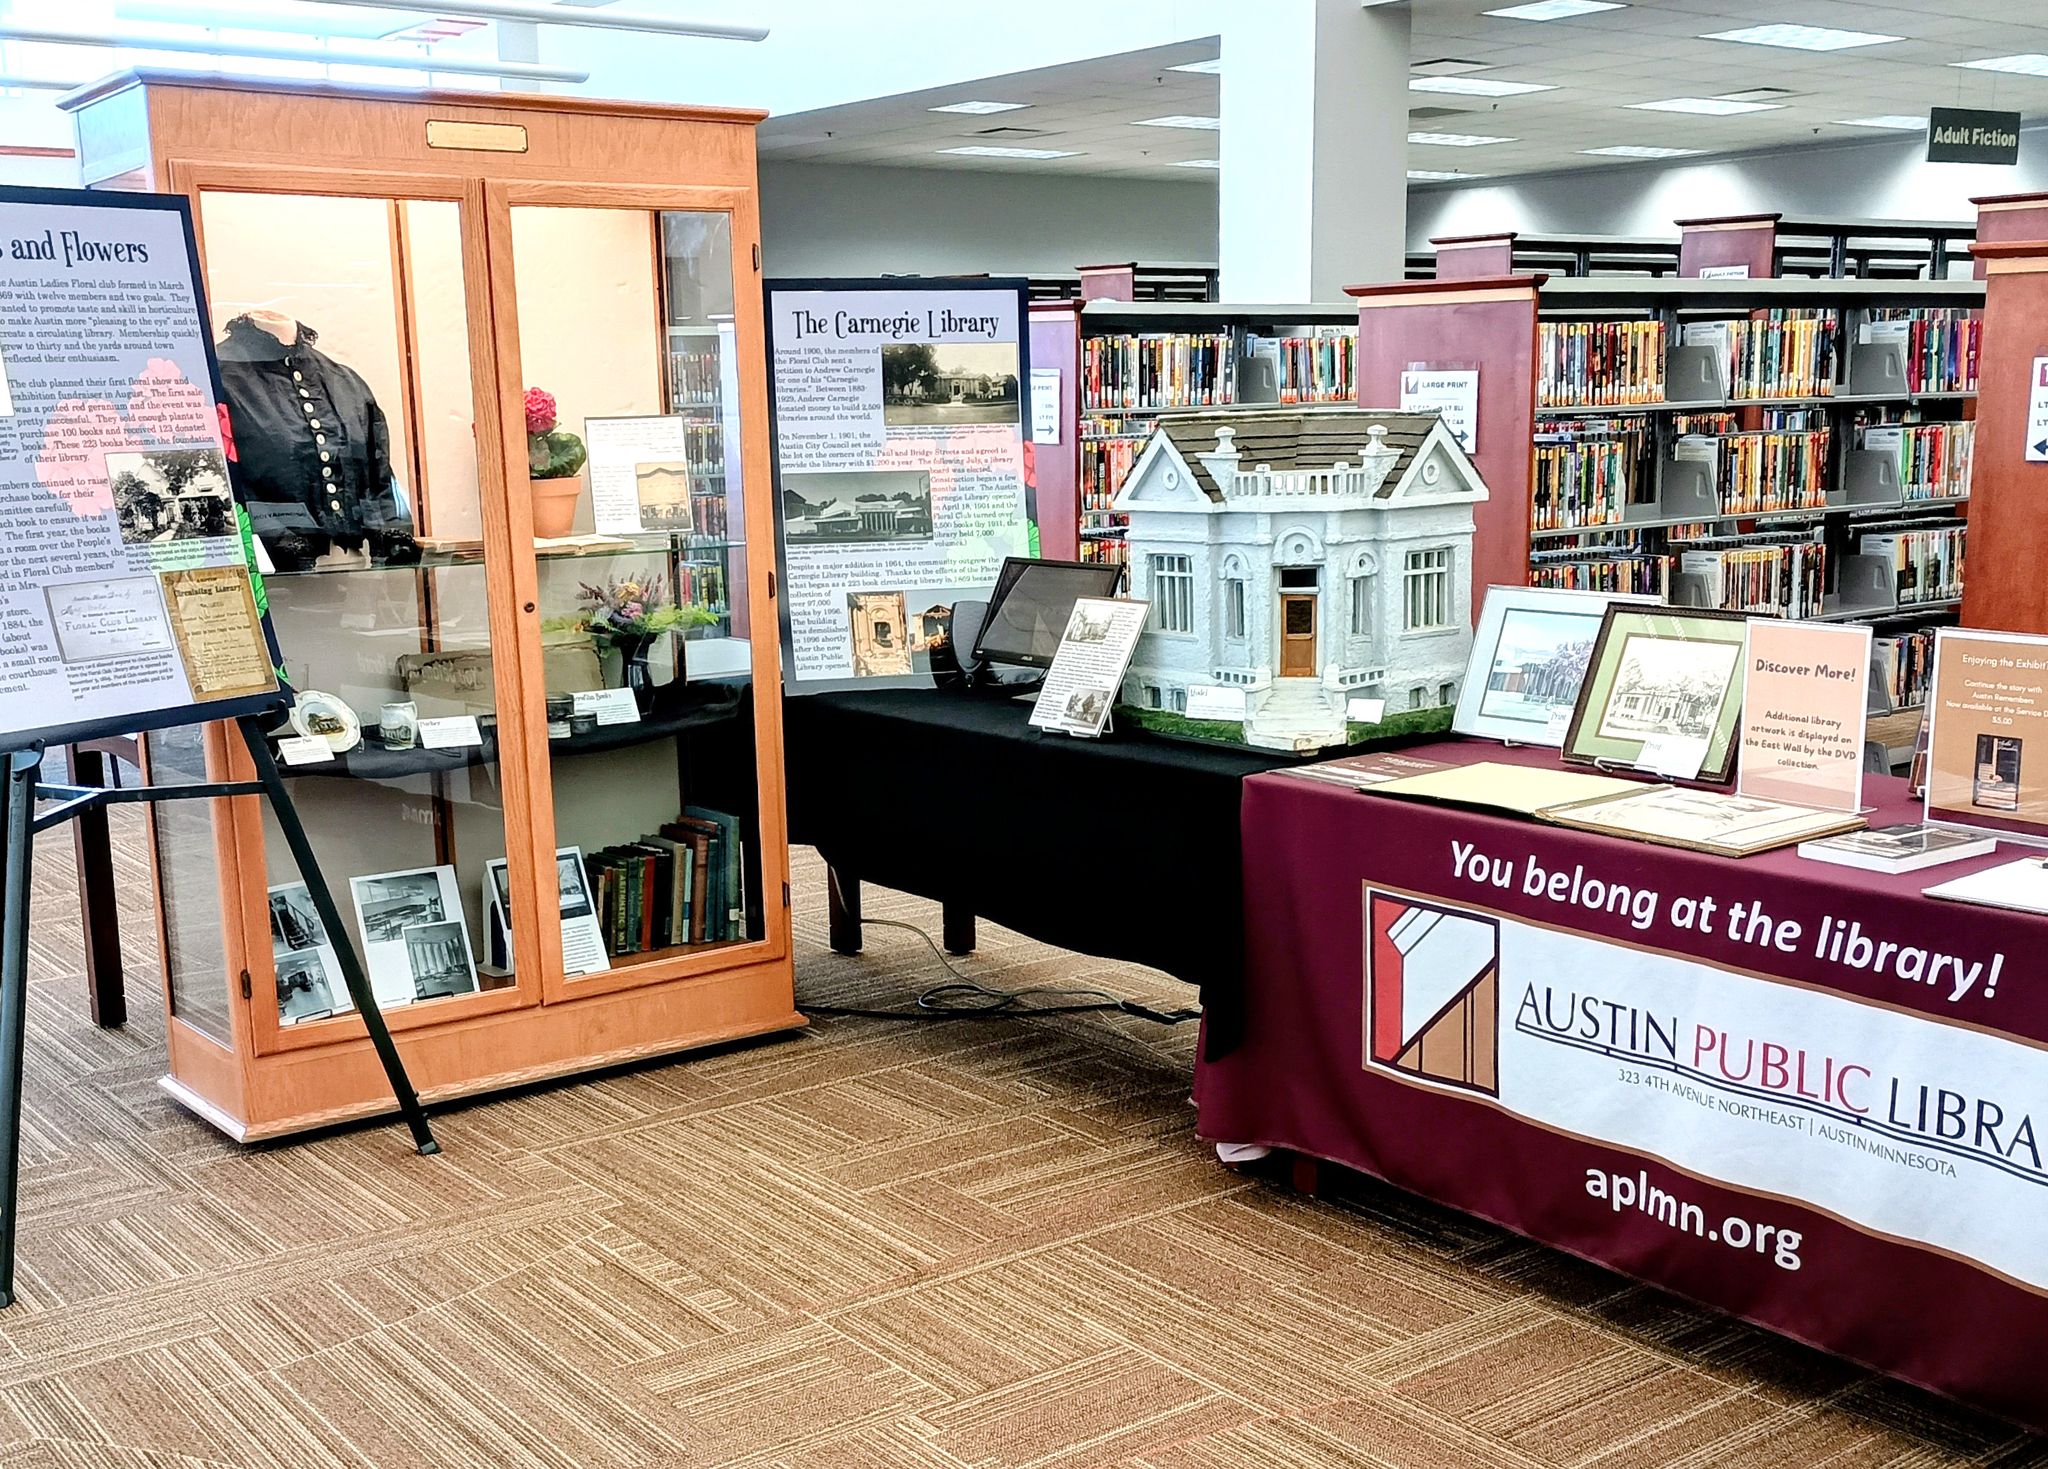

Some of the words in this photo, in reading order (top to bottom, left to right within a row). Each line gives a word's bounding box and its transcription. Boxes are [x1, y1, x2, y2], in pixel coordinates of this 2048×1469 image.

[1934, 126, 1969, 144] Adult
[1972, 128, 2016, 147] Fiction
[11, 230, 56, 260] and
[61, 232, 148, 267] Flowers
[8, 278, 38, 287] Austin
[40, 279, 69, 288] Ladies
[71, 279, 97, 288] Floral
[98, 280, 116, 288] club
[118, 280, 147, 289] formed
[148, 280, 157, 289] in
[158, 280, 185, 290] March
[14, 291, 36, 300] with
[37, 291, 66, 300] twelve
[68, 292, 107, 301] members
[109, 292, 124, 301] and
[126, 292, 142, 301] two
[143, 293, 166, 304] goals.
[170, 293, 190, 304] They
[29, 304, 38, 313] to
[40, 305, 76, 315] promote
[77, 305, 99, 313] taste
[100, 305, 117, 313] and
[118, 305, 136, 314] skill
[138, 305, 147, 314] in
[148, 306, 196, 314] horticulture
[7, 317, 32, 325] make
[34, 317, 63, 325] Austin
[129, 317, 137, 325] to
[139, 317, 153, 325] the
[173, 317, 188, 325] and
[189, 317, 198, 325] to
[792, 310, 828, 339] The
[835, 310, 921, 339] Carnegie
[927, 309, 1000, 339] Library
[36, 329, 83, 340] circulating
[84, 329, 115, 340] library.
[119, 329, 170, 339] Membership
[171, 328, 199, 339] quickly
[824, 347, 836, 355] the
[775, 367, 803, 375] petition
[843, 366, 876, 375] Carnegie
[5, 531, 24, 540] The
[26, 529, 45, 539] first
[46, 530, 69, 539] year,
[70, 526, 85, 536] the
[86, 525, 111, 534] books
[60, 540, 75, 549] the
[11, 556, 26, 565] the
[28, 554, 48, 564] next
[50, 552, 82, 562] several
[83, 552, 110, 561] years,
[111, 548, 125, 557] the
[11, 569, 21, 578] in
[23, 566, 50, 577] Floral
[52, 564, 73, 575] Club
[807, 617, 837, 626] building
[796, 654, 819, 662] Austin
[821, 653, 844, 661] Public
[1962, 653, 1998, 668] Enjoying
[2000, 656, 2014, 667] the
[796, 663, 823, 672] Library
[1755, 659, 1810, 675] Discover
[1815, 664, 1856, 682] More!
[1964, 679, 1994, 690] Continue
[1996, 682, 2008, 691] the
[2009, 684, 2026, 695] story
[2028, 685, 2042, 694] with
[1972, 692, 1993, 702] Austin
[1994, 693, 2034, 705] Remembers
[1946, 700, 1961, 709] Now
[1962, 702, 1993, 713] available
[1994, 705, 2002, 713] at
[2003, 705, 2014, 714] the
[2016, 706, 2039, 717] Service
[1765, 710, 1809, 724] Additional
[1811, 716, 1842, 730] library
[1991, 716, 2012, 726] $5.00
[1750, 725, 1786, 737] artwork
[1788, 729, 1795, 737] is
[1797, 728, 1839, 744] displayed
[1841, 736, 1852, 744] on
[1745, 738, 1760, 748] the
[1761, 740, 1781, 751] East
[1782, 742, 1802, 754] Wall
[1804, 745, 1815, 758] by
[1818, 747, 1833, 757] the
[1835, 749, 1856, 761] DVD
[1777, 758, 1819, 771] collection.
[1450, 841, 1512, 889] You
[1522, 855, 1658, 929] belong
[1670, 896, 1716, 934] at
[1728, 901, 1802, 952] the
[1815, 916, 2005, 1002] library!
[1518, 982, 1678, 1060] AUSTIN
[1694, 1024, 1871, 1113] PUBLIC
[1889, 1078, 2042, 1168] LIBRA
[1618, 1068, 1640, 1086] 323
[1644, 1073, 1670, 1093] 4TH
[1671, 1082, 1715, 1110] AVENUE
[1718, 1099, 1804, 1131] NORTHEAST
[1585, 1167, 1804, 1270] aplmn.org
